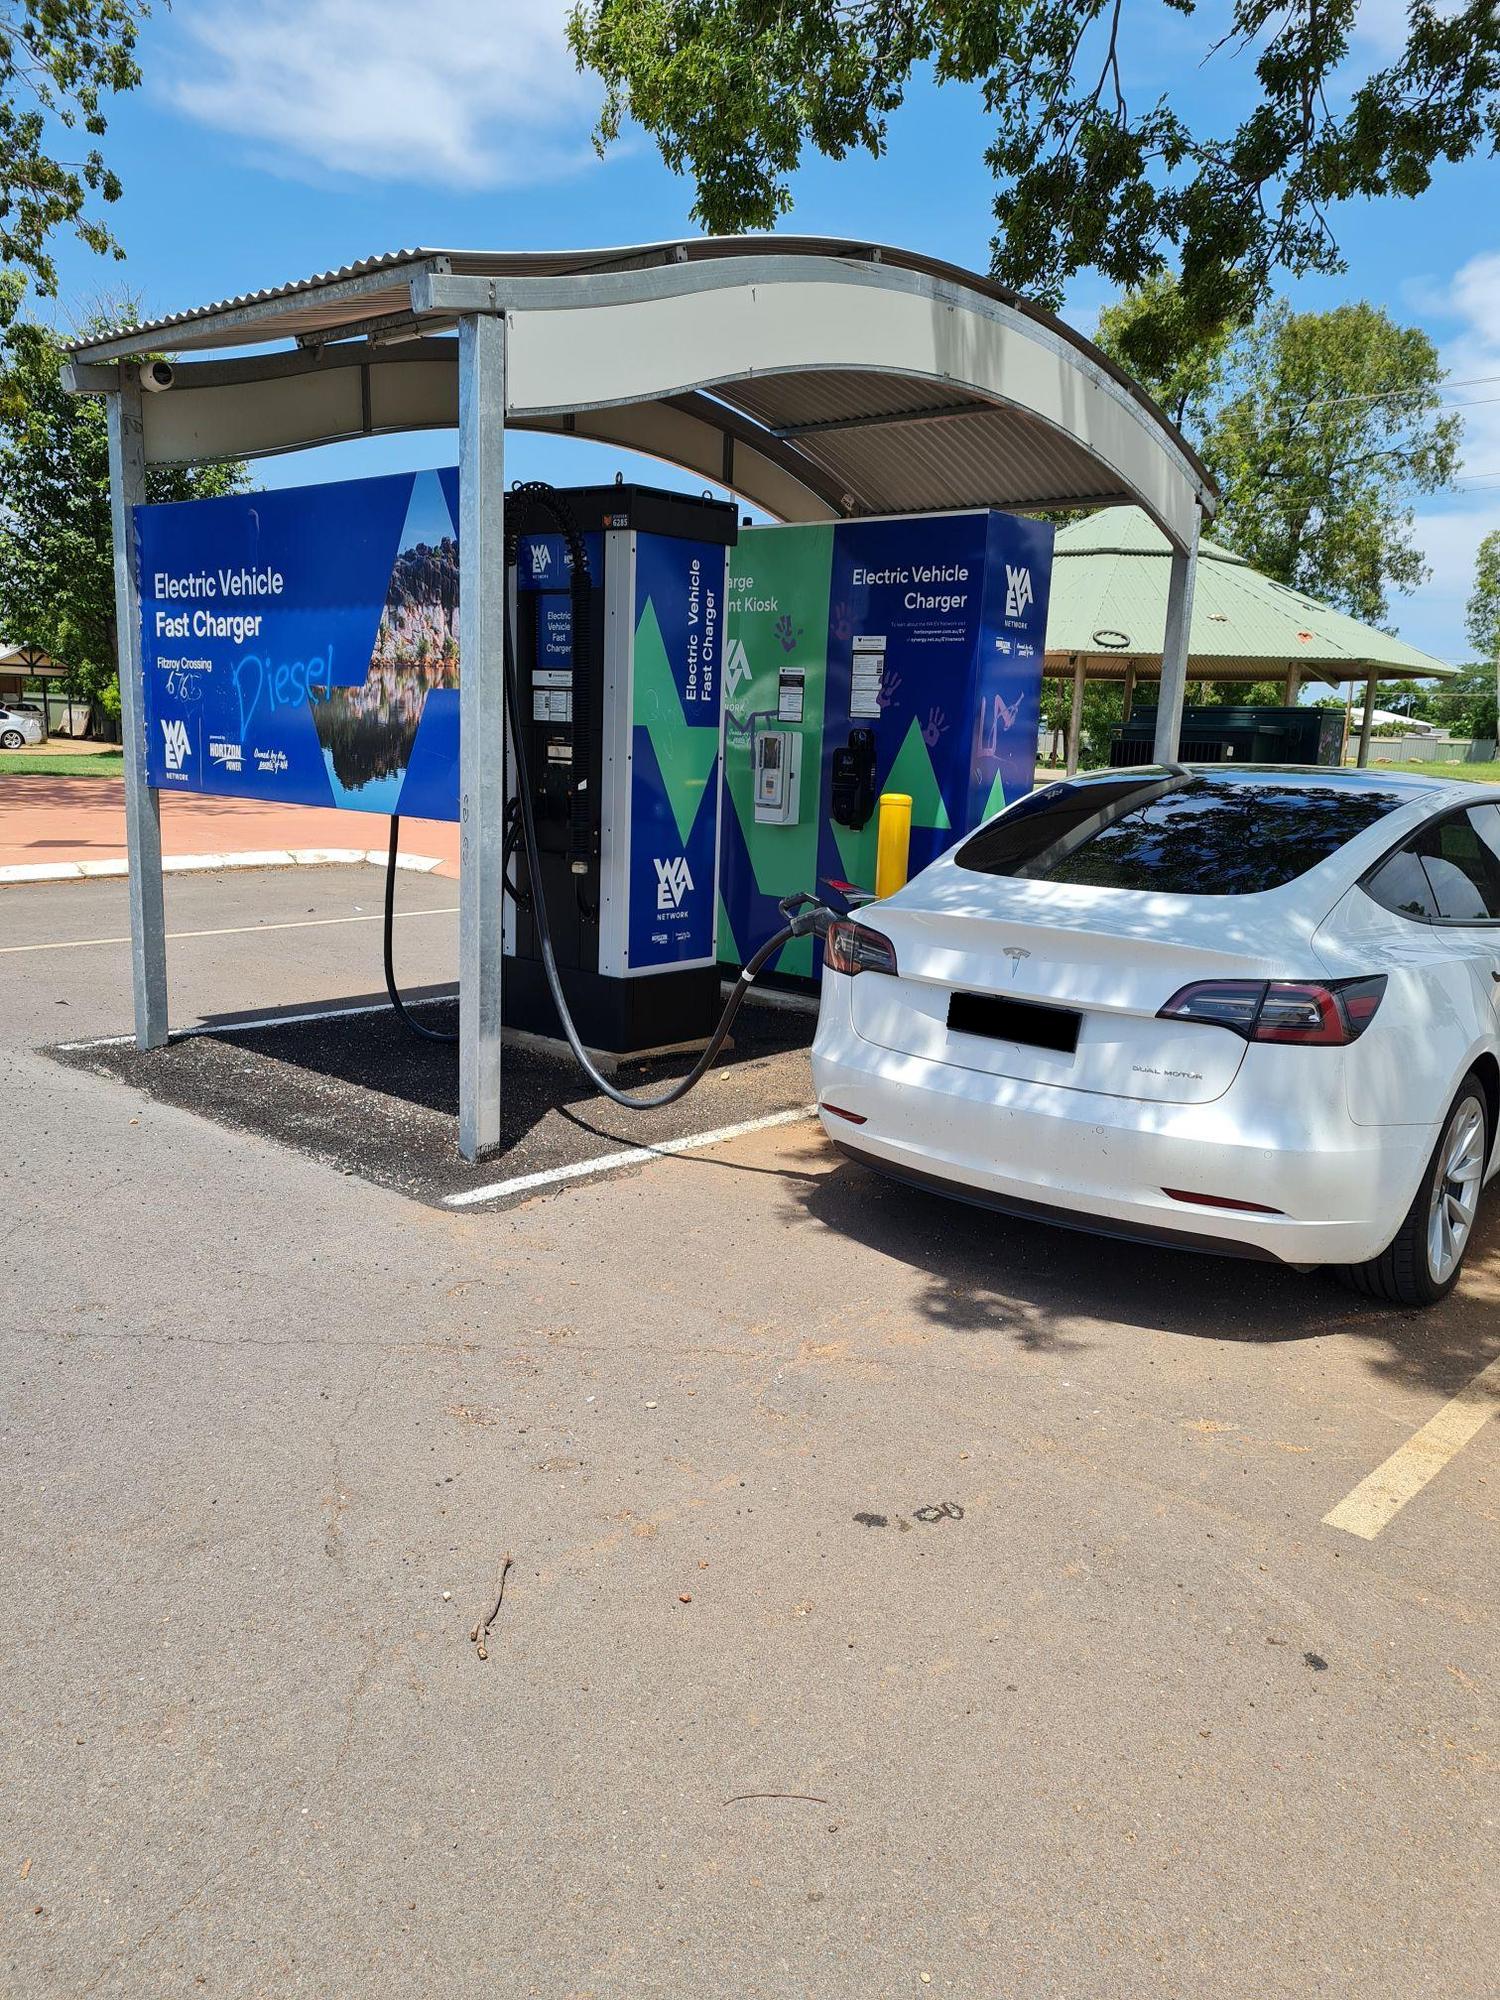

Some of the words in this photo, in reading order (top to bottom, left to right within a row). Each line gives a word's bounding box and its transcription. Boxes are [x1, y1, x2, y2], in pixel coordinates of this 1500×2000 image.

[530, 544, 552, 564] WA
[154, 570, 216, 599] Electric
[218, 566, 284, 597] Vehicle
[728, 576, 754, 592] arge
[852, 567, 909, 585] Electric
[912, 564, 969, 583] Vehicle
[1005, 564, 1034, 604] WA
[688, 559, 700, 626] Vehicle
[904, 592, 968, 613] Charger
[744, 596, 778, 612] Kiosk
[547, 611, 572, 620] Electric
[702, 588, 717, 661] Charger
[155, 611, 190, 638] Fast
[193, 610, 262, 644] Charger
[547, 622, 571, 631] Vehicle
[552, 633, 566, 642] Fast
[546, 643, 572, 655] Charger
[157, 656, 180, 672] Fitzroy
[181, 656, 212, 673] Crossing
[685, 634, 698, 701] Electric
[701, 665, 713, 701] Fast
[231, 644, 333, 743] Diesel
[160, 719, 192, 755] WA
[209, 742, 242, 759] HORIZON
[166, 772, 189, 781] NETWORK
[225, 761, 242, 772] POWER
[653, 857, 695, 891] WA
[656, 911, 689, 921] NETWORK
[1132, 1065, 1161, 1075] DUAL
[1164, 1070, 1203, 1080] MOTOR
